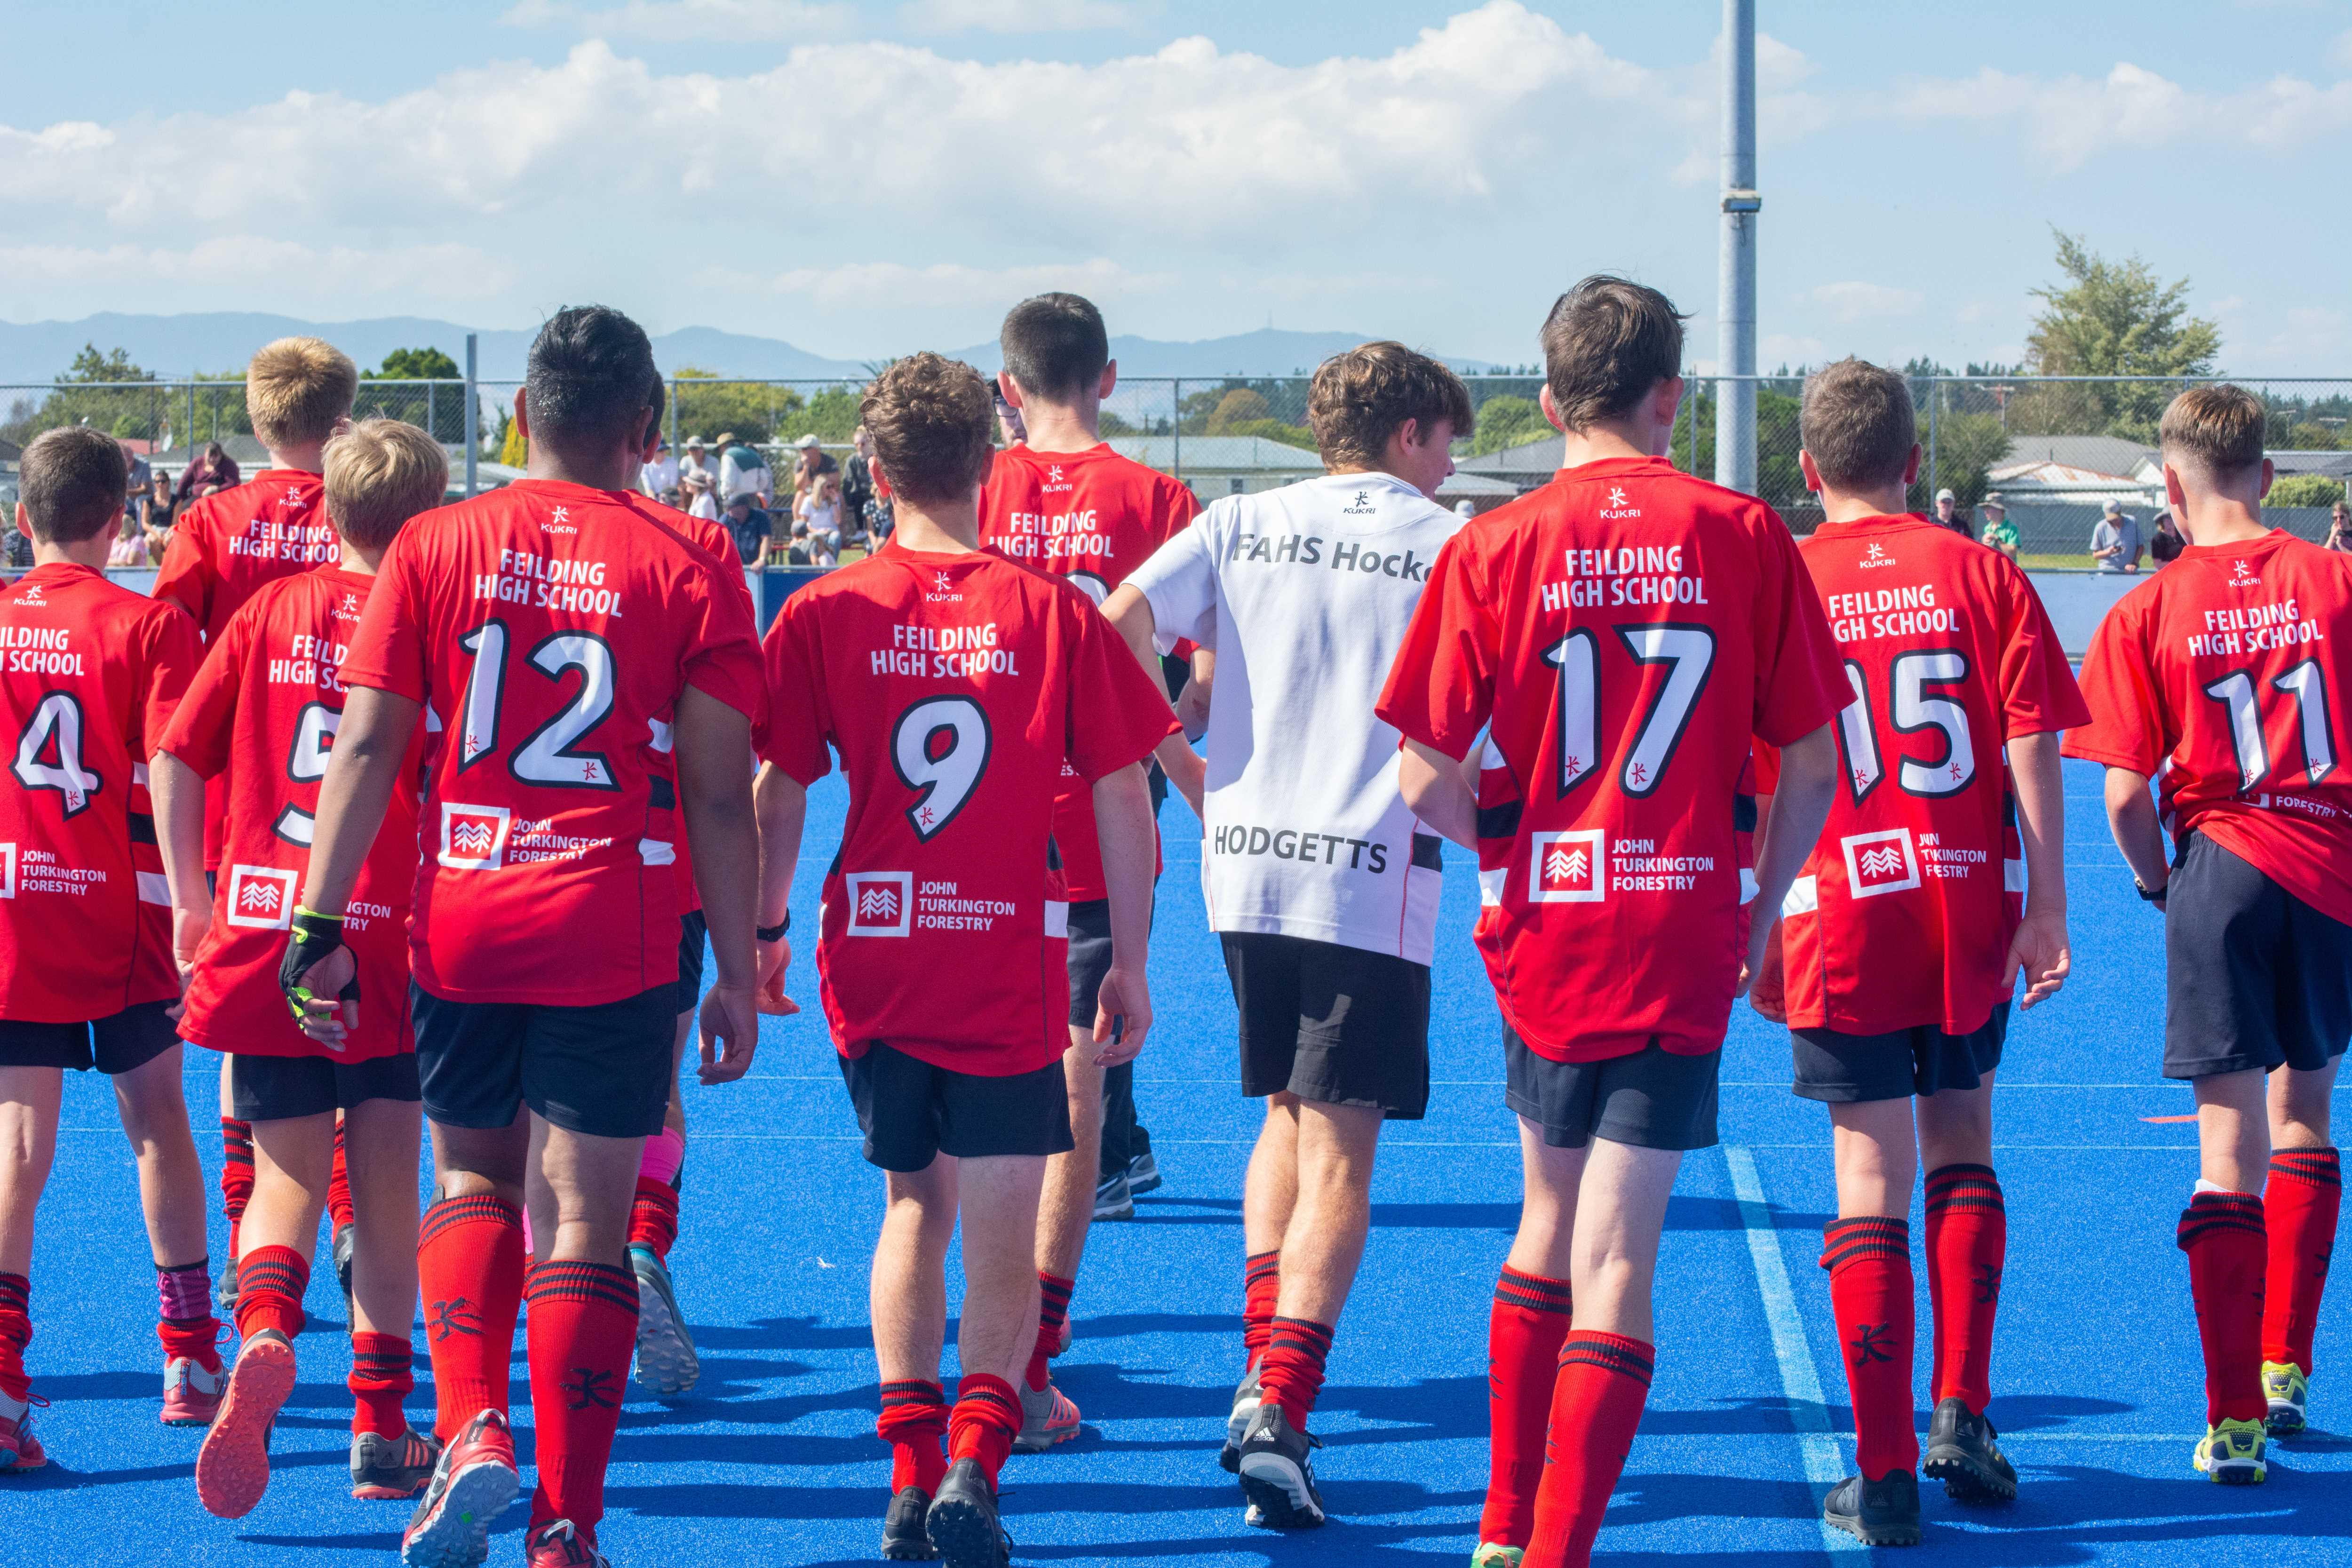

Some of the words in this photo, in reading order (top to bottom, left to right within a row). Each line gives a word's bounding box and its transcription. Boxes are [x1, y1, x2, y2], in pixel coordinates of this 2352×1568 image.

[1042, 484, 1072, 493] KUKRI
[279, 498, 307, 508] KUKRI
[1600, 509, 1640, 519] KUKRI
[250, 519, 332, 543] FEILDING
[541, 523, 577, 534] KUKRI
[1010, 510, 1097, 536] FEILDING
[229, 535, 276, 557] HIGH
[279, 541, 342, 565] SCHOO
[1043, 533, 1113, 559] SCHOOL
[1233, 534, 1323, 564] FAHS
[500, 548, 606, 585] FEILDING
[1565, 545, 1682, 576] FEILDING
[1859, 558, 1896, 568] KUKRI
[1542, 580, 1603, 612] HIGH
[1611, 576, 1708, 605] SCHOOL
[2229, 578, 2260, 587] KUKRI
[13, 598, 47, 606] KUKRI
[475, 573, 530, 604] HIGH
[535, 583, 621, 617] SCHOOL
[926, 593, 962, 602] KUKRI
[1828, 584, 1935, 618] FEILDING
[331, 609, 361, 622] KUKR
[1828, 617, 1867, 643] GH
[1872, 608, 1959, 637] SCHOOL
[2205, 599, 2298, 631] FEILDING
[0, 626, 70, 651] ILDING
[894, 622, 996, 652] FEILDING
[2187, 633, 2240, 656] HIGH
[2245, 618, 2323, 652] SCHOOL
[291, 634, 349, 667] FEILD
[9, 650, 84, 676] SCHOOL
[269, 660, 316, 684] HIGH
[871, 650, 925, 676] HIGH
[934, 649, 1018, 677] SCHOOL
[458, 617, 622, 792] 12
[1539, 621, 1718, 801] 17
[1836, 647, 1976, 809] 15
[2202, 656, 2338, 795] 11
[8, 689, 103, 822] 4
[890, 694, 993, 844] 9
[2276, 795, 2337, 819] FORESTRY
[513, 818, 552, 833] JOHN
[512, 834, 612, 850] TURKINGTON
[1216, 826, 1387, 874] HODGETTS
[1613, 839, 1653, 853] JOHN
[22, 851, 54, 862] JOHN
[509, 848, 587, 862] FORESTRY
[1613, 858, 1713, 872] TURKINGTON
[1921, 848, 1986, 863] TKINGTON
[22, 865, 106, 881] TURKINGTON
[1925, 864, 1969, 878] FESTRY
[22, 879, 87, 895] FORESTRY
[920, 882, 956, 894] JOHN
[1613, 876, 1695, 891] FORESTRY
[920, 899, 1015, 915] TURKINGTON
[918, 915, 993, 930] FORESTRY
